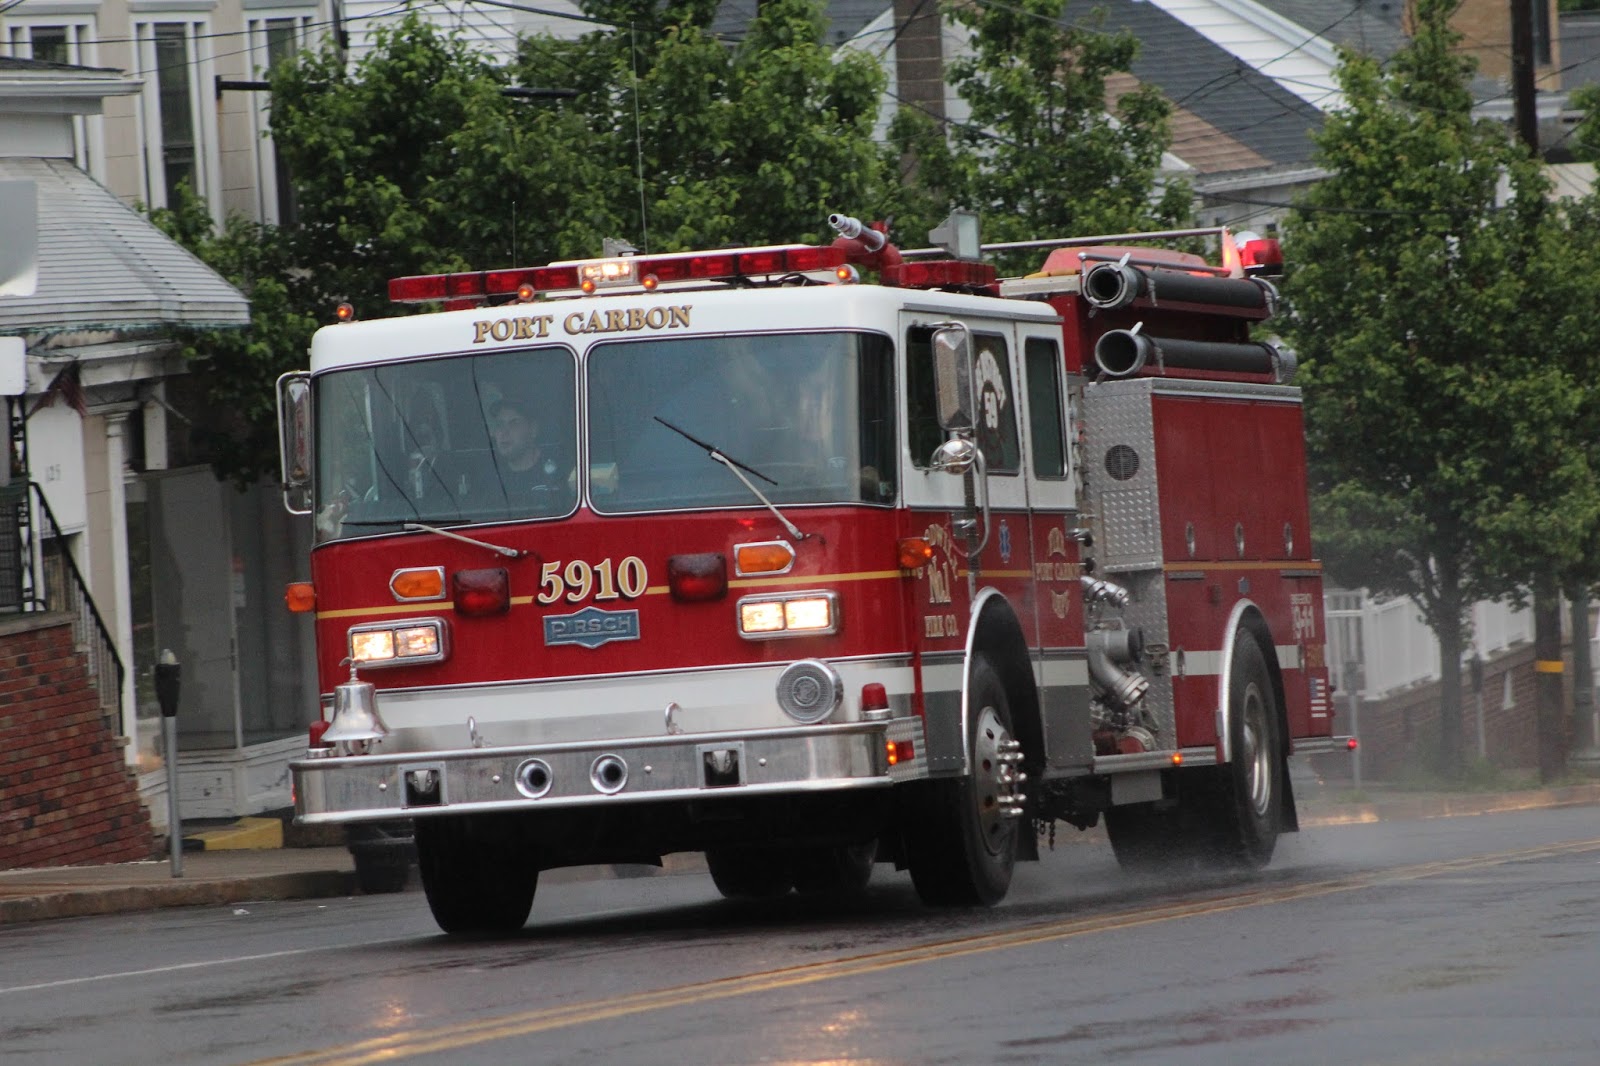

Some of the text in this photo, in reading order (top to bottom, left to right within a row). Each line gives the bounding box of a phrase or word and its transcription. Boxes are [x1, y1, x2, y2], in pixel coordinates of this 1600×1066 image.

[473, 304, 693, 344] PORT CARBON
[537, 556, 648, 603] 5910
[551, 615, 632, 638] PIRSCH
